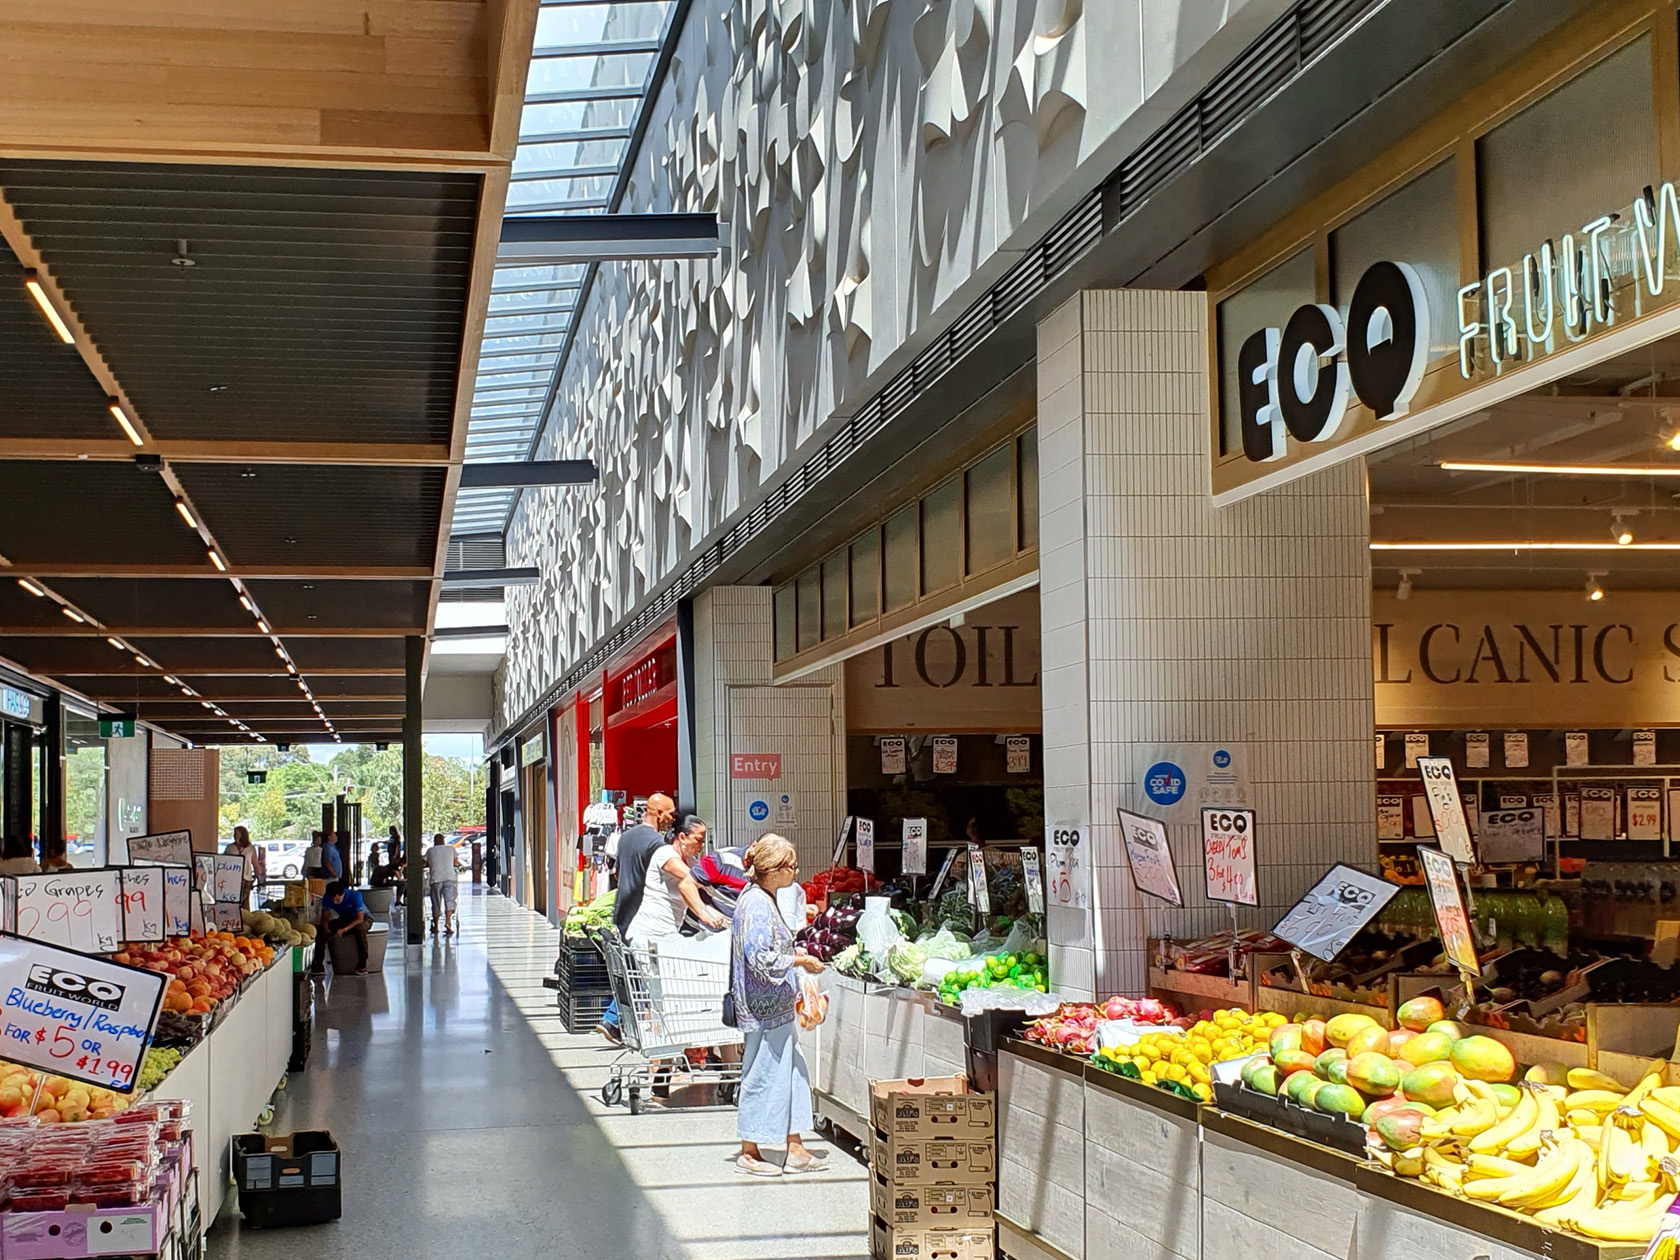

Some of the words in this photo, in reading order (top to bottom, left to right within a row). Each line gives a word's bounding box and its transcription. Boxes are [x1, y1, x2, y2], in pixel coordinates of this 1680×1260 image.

[1457, 213, 1621, 379] FRUIT
[734, 757, 778, 775] Entry
[1152, 786, 1179, 795] SAFE
[44, 878, 104, 903] Grapes
[68, 991, 119, 1011] WORLD
[4, 1022, 31, 1045] FOR
[81, 1038, 102, 1056] OR
[76, 1054, 134, 1084] $1.99
